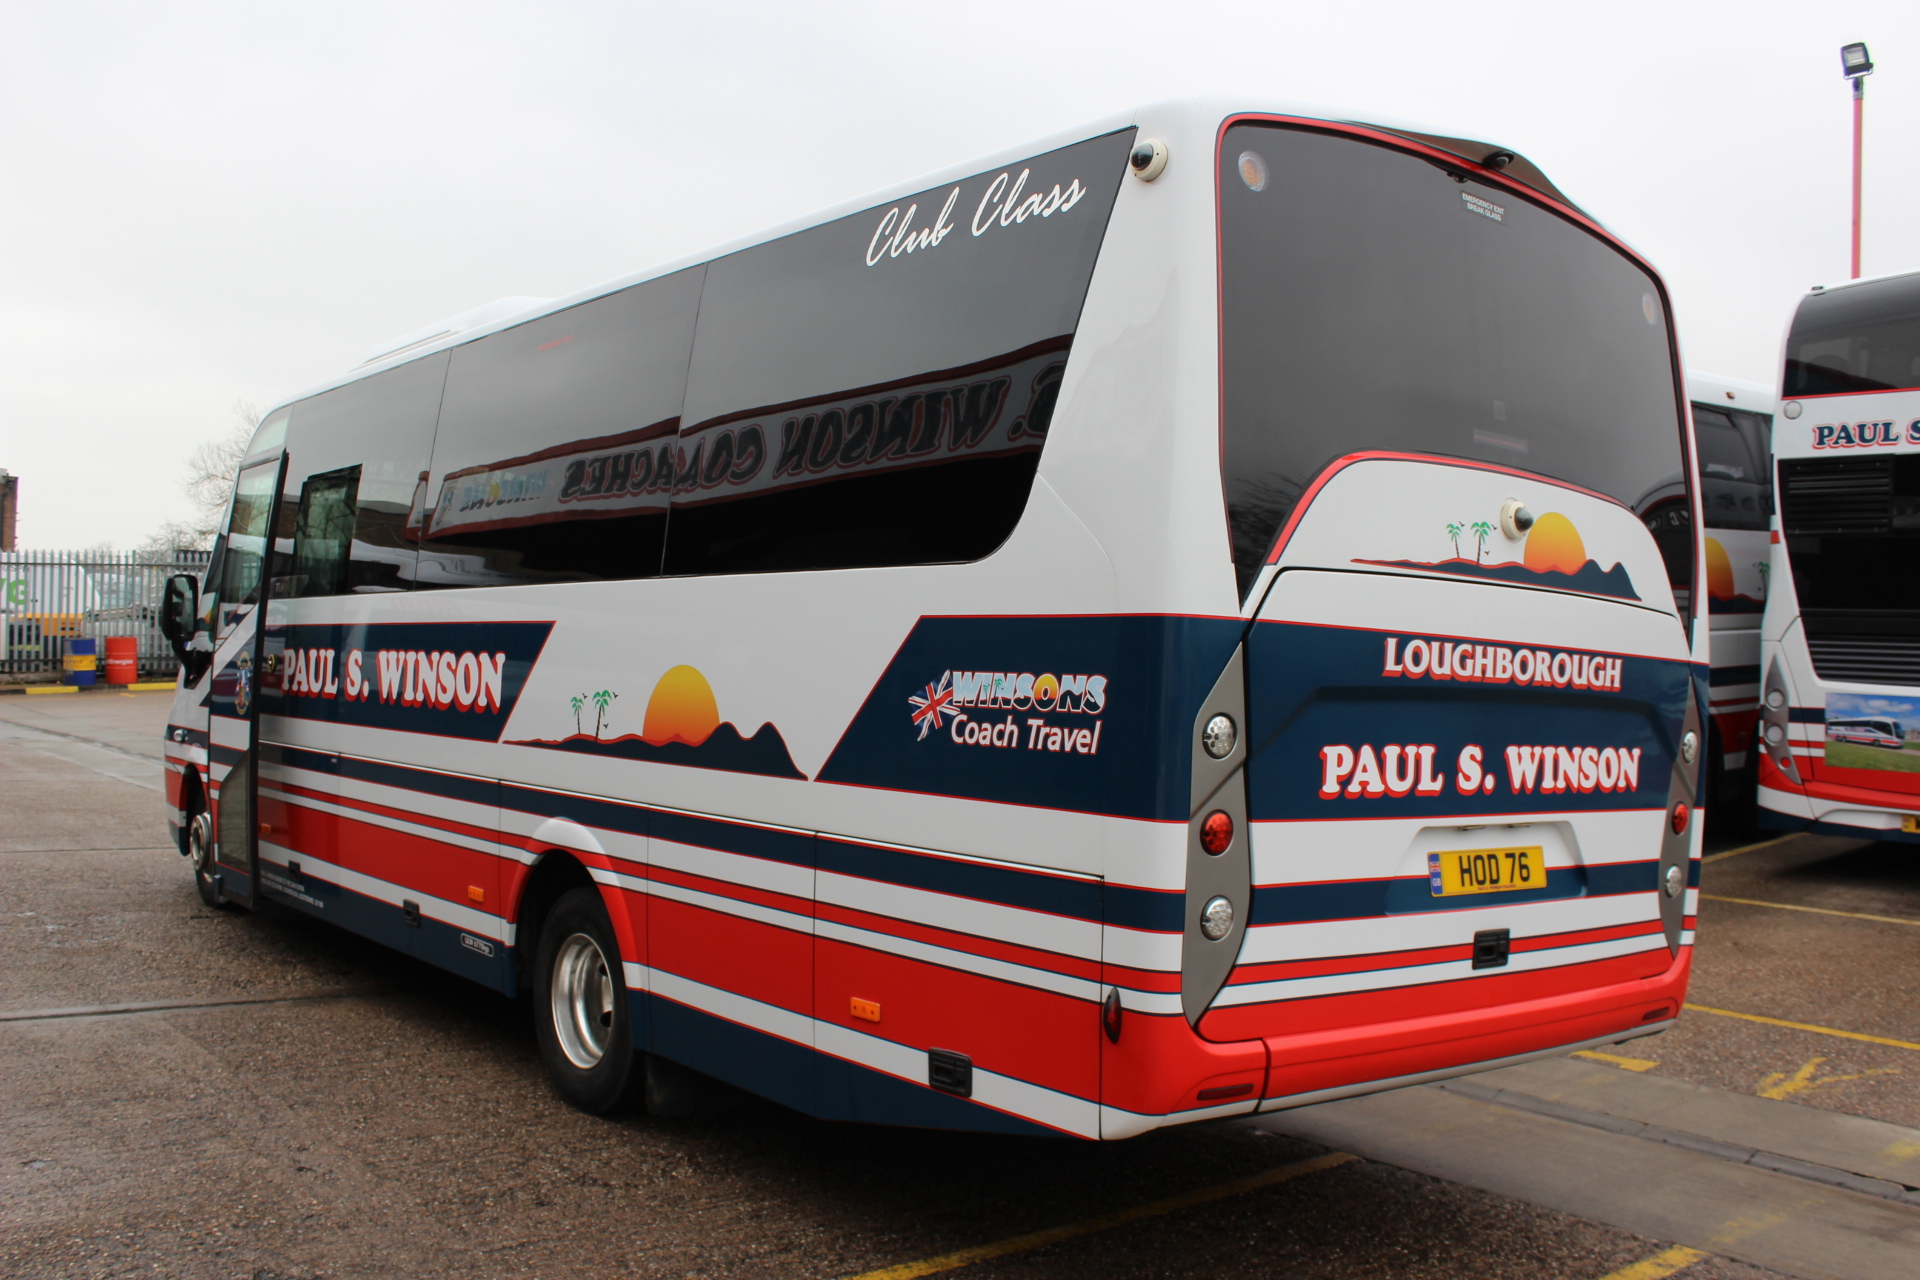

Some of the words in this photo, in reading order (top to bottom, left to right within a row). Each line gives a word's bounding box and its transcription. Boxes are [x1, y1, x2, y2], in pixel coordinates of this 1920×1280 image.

[866, 187, 959, 266] Club
[972, 168, 1087, 236] Class
[1462, 193, 1493, 210] EMERGENCY
[1493, 205, 1505, 215] EXIT
[1466, 202, 1485, 215] BREAK
[1484, 209, 1502, 221] GLASS
[1812, 420, 1902, 449] PAUL
[281, 648, 338, 699] PAUL
[344, 648, 370, 702] S.
[376, 649, 506, 715] WINSON
[1382, 637, 1623, 692] LOUGHBOROUGH
[952, 671, 1108, 714] WINSONS
[951, 713, 1019, 748] Coach
[1027, 717, 1103, 755] Travel
[1319, 743, 1445, 800] PAUL
[1456, 744, 1495, 797] S.
[1504, 744, 1642, 794] WINSON
[1432, 878, 1442, 887] GB
[1459, 853, 1500, 887] HOD
[1505, 852, 1531, 883] 76
